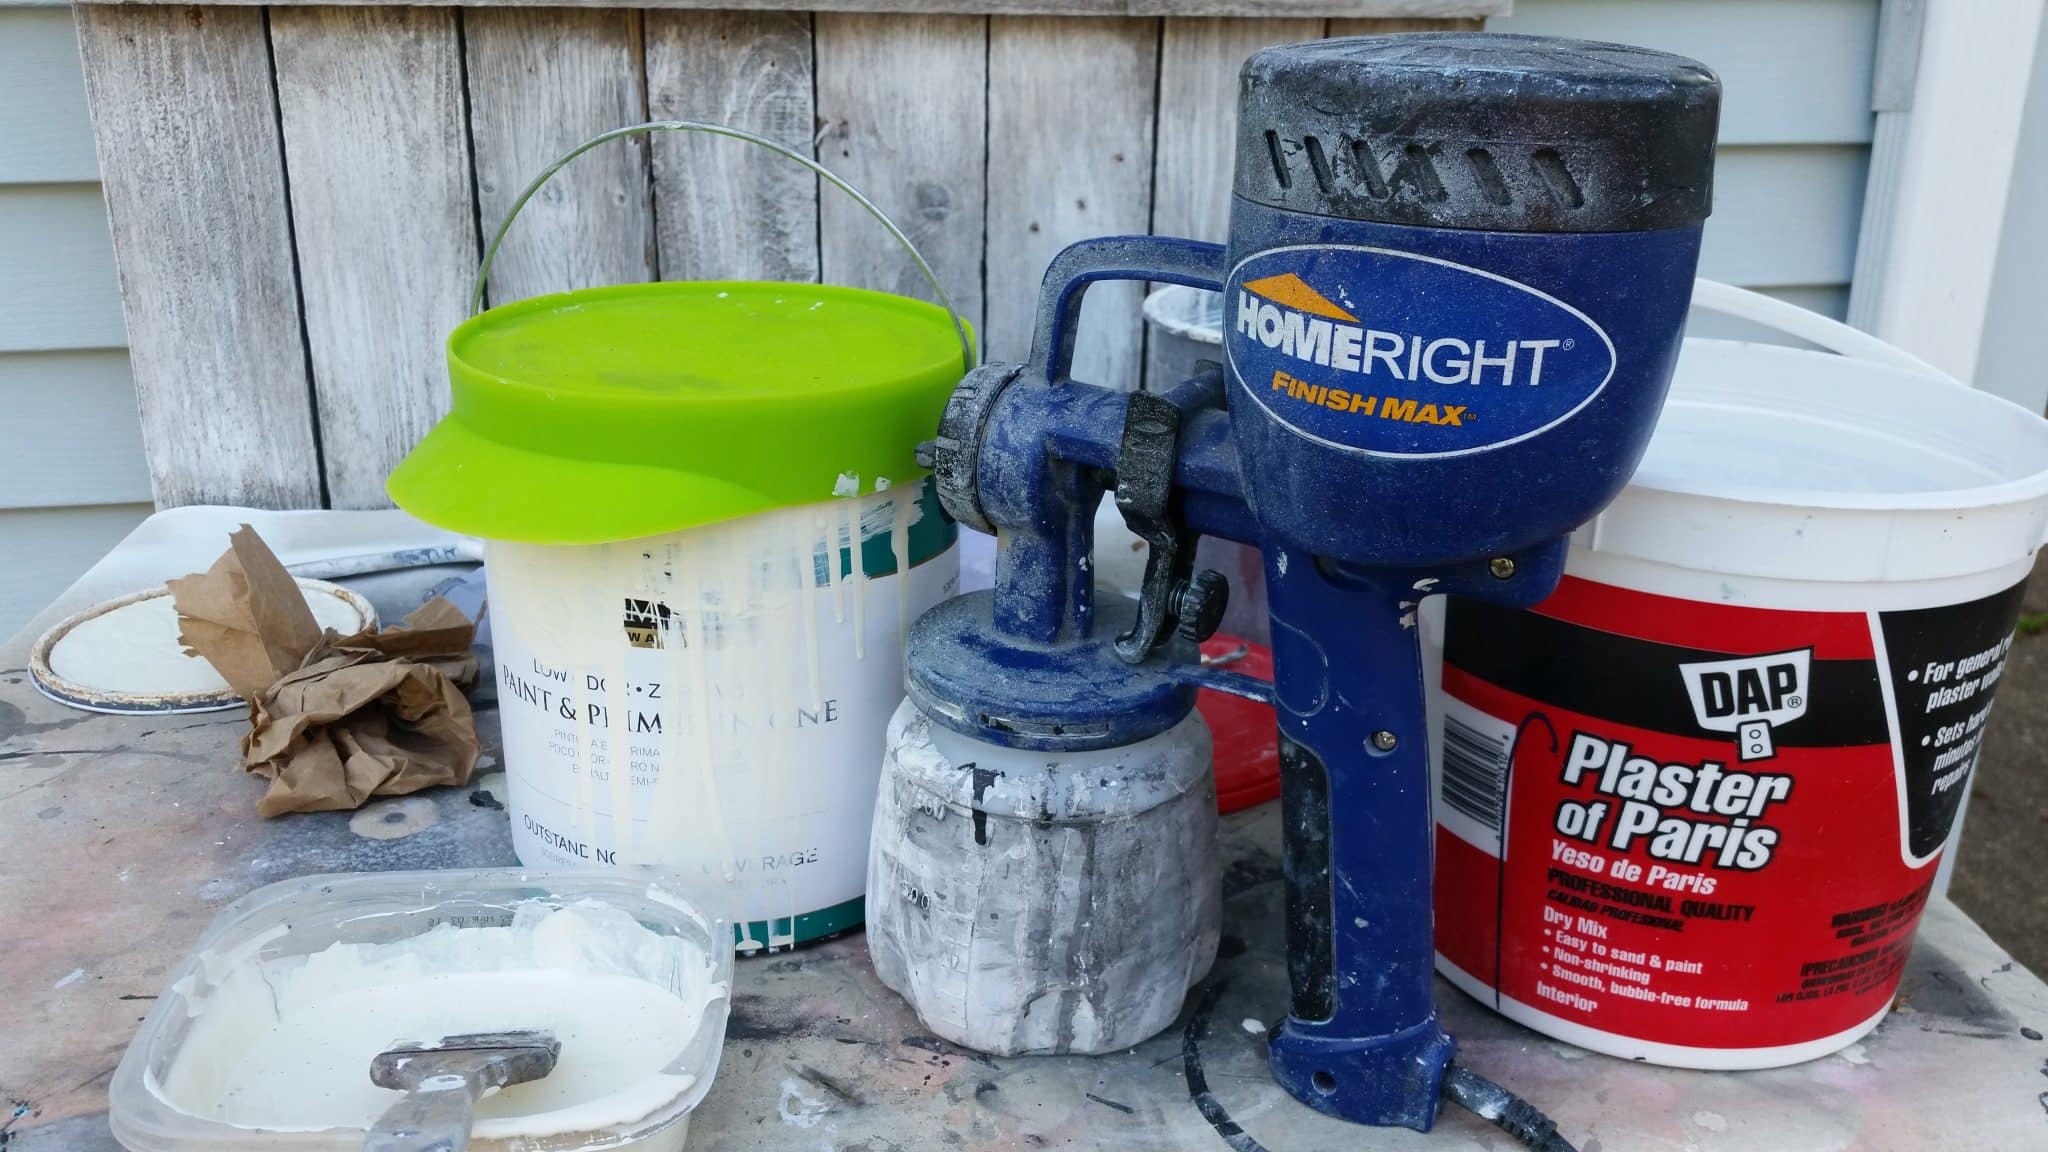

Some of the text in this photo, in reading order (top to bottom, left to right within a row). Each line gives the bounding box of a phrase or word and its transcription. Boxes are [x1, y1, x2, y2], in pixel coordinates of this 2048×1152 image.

[1272, 371, 1377, 416] FINISH
[503, 664, 551, 712] PAINT
[1923, 660, 1955, 684] For
[1926, 677, 1981, 713] plaster
[1934, 720, 1966, 748] Sets
[1563, 734, 1792, 818] Plaster
[1556, 801, 1778, 870] of Paris
[1551, 840, 1718, 896] Yeso de Paris
[1547, 866, 1755, 922] PROFESSIONAL QUALITY
[1543, 905, 1608, 940] Dry Mix
[1553, 946, 1651, 986] Non-shrinking
[1555, 930, 1704, 976] Easy to sand & paint
[1536, 979, 1598, 1014] Interior
[1551, 963, 1750, 1012] Smooth, bubble-free formula
